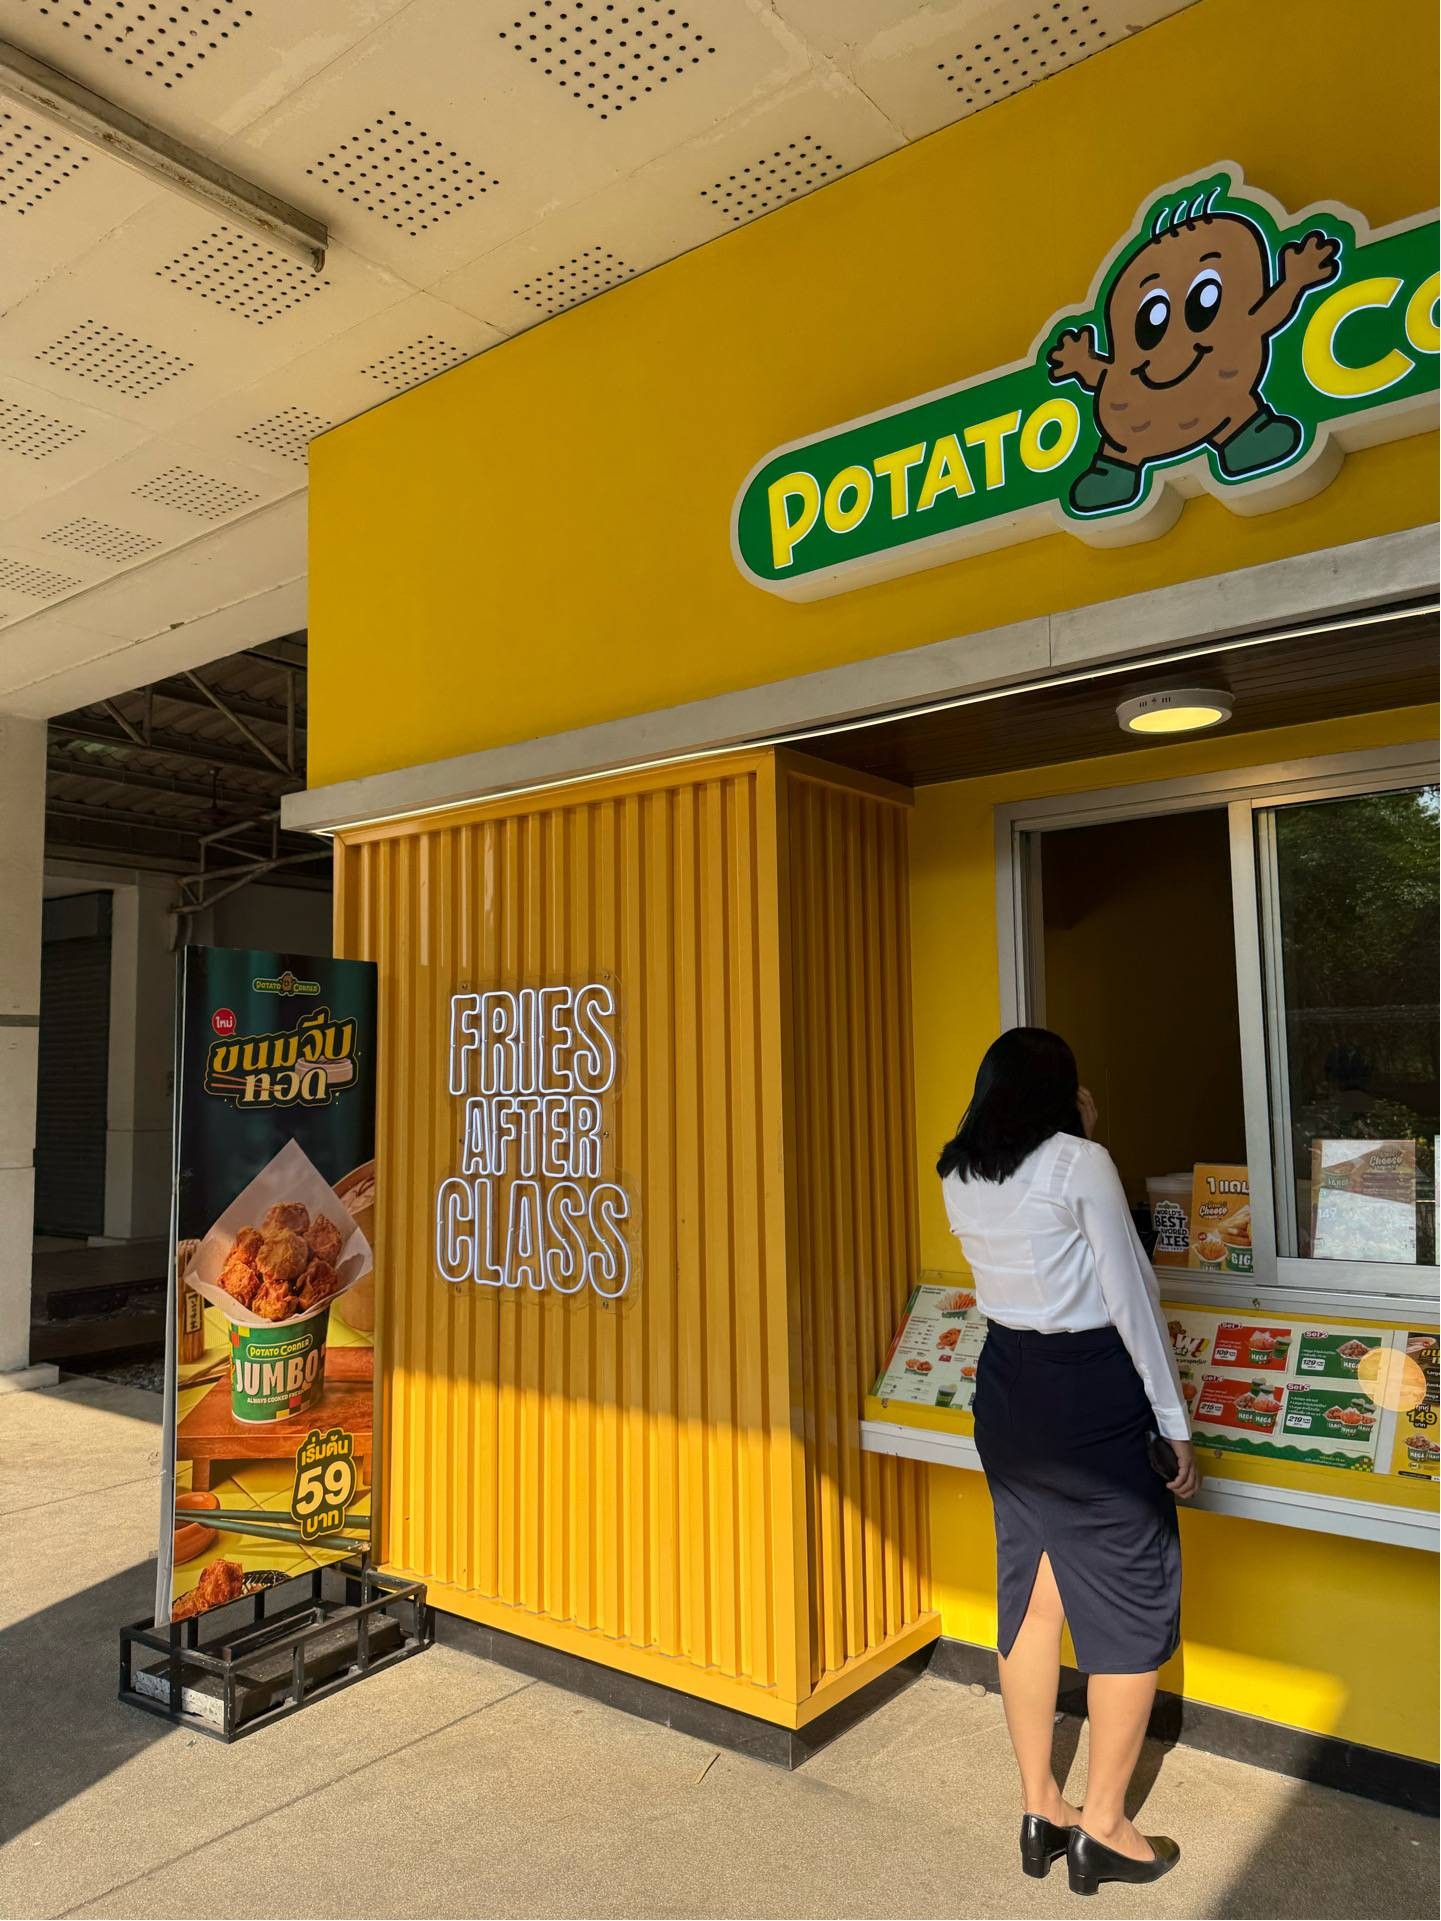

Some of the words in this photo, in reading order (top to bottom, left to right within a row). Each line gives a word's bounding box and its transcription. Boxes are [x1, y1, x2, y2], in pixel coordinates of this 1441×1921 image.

[768, 399, 1081, 569] POTATO
[256, 981, 281, 990] POTATO
[215, 1015, 233, 1029] ใหม่
[212, 1013, 353, 1073] ขนมจีบ
[450, 984, 616, 1095] FRIES
[243, 1068, 328, 1102] ทอด
[462, 1096, 602, 1178] AFTER
[437, 1177, 630, 1298] CLASS
[1154, 1215, 1187, 1229] BEST
[250, 1345, 279, 1357] POTATO
[280, 1337, 310, 1356] CORNER
[235, 1348, 319, 1396] JUMBO
[247, 1396, 268, 1405] ALWAYS
[267, 1394, 289, 1403] COOKED
[1408, 1411, 1437, 1425] 149
[301, 1435, 349, 1466] เริ่มต้น
[296, 1460, 351, 1515] 59
[306, 1509, 339, 1533] บาท
